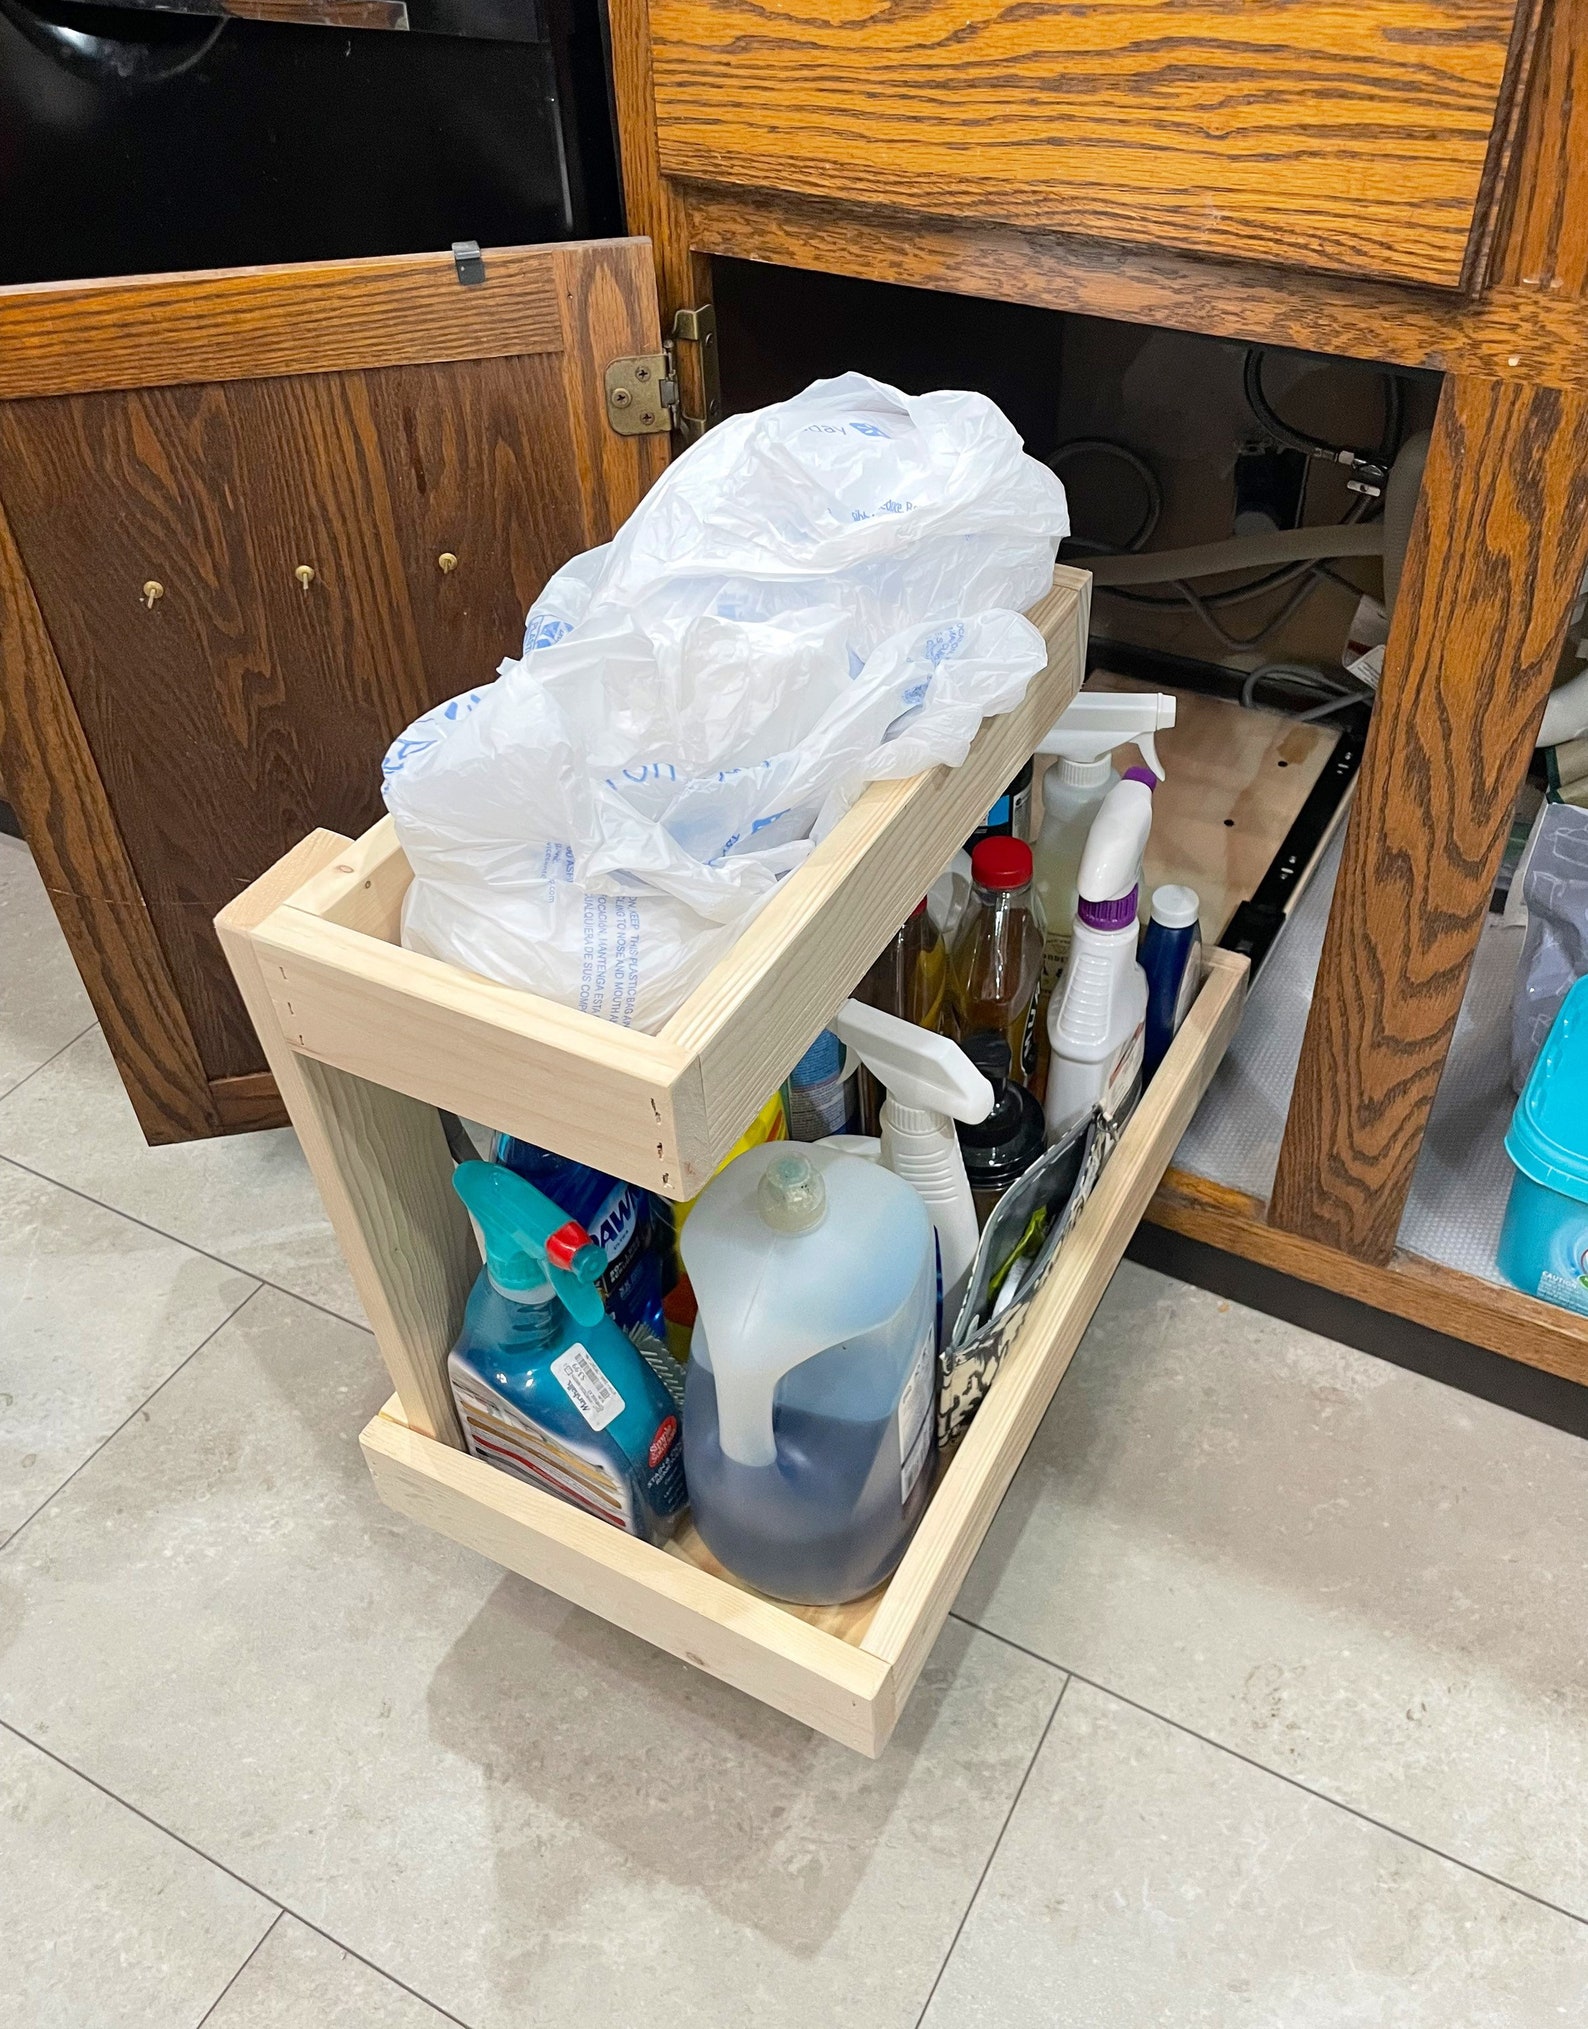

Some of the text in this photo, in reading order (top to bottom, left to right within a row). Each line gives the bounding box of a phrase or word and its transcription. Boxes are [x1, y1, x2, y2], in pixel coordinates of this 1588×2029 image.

[617, 919, 626, 930] TO
[629, 911, 639, 930] KEEP
[584, 947, 593, 960] DE
[616, 932, 626, 958] NOSE
[629, 935, 639, 957] THIS
[582, 962, 592, 982] SUS
[595, 937, 607, 991] MANTENGA
[615, 959, 624, 979] AND
[627, 957, 638, 995] PLASTIC
[591, 993, 603, 1014] ESTA
[610, 982, 623, 1013] MOUTH
[624, 997, 635, 1014] BAG
[1542, 1271, 1577, 1289] CAUTION
[567, 1380, 591, 1412] Marshalls
[647, 1462, 665, 1489] STAIN
